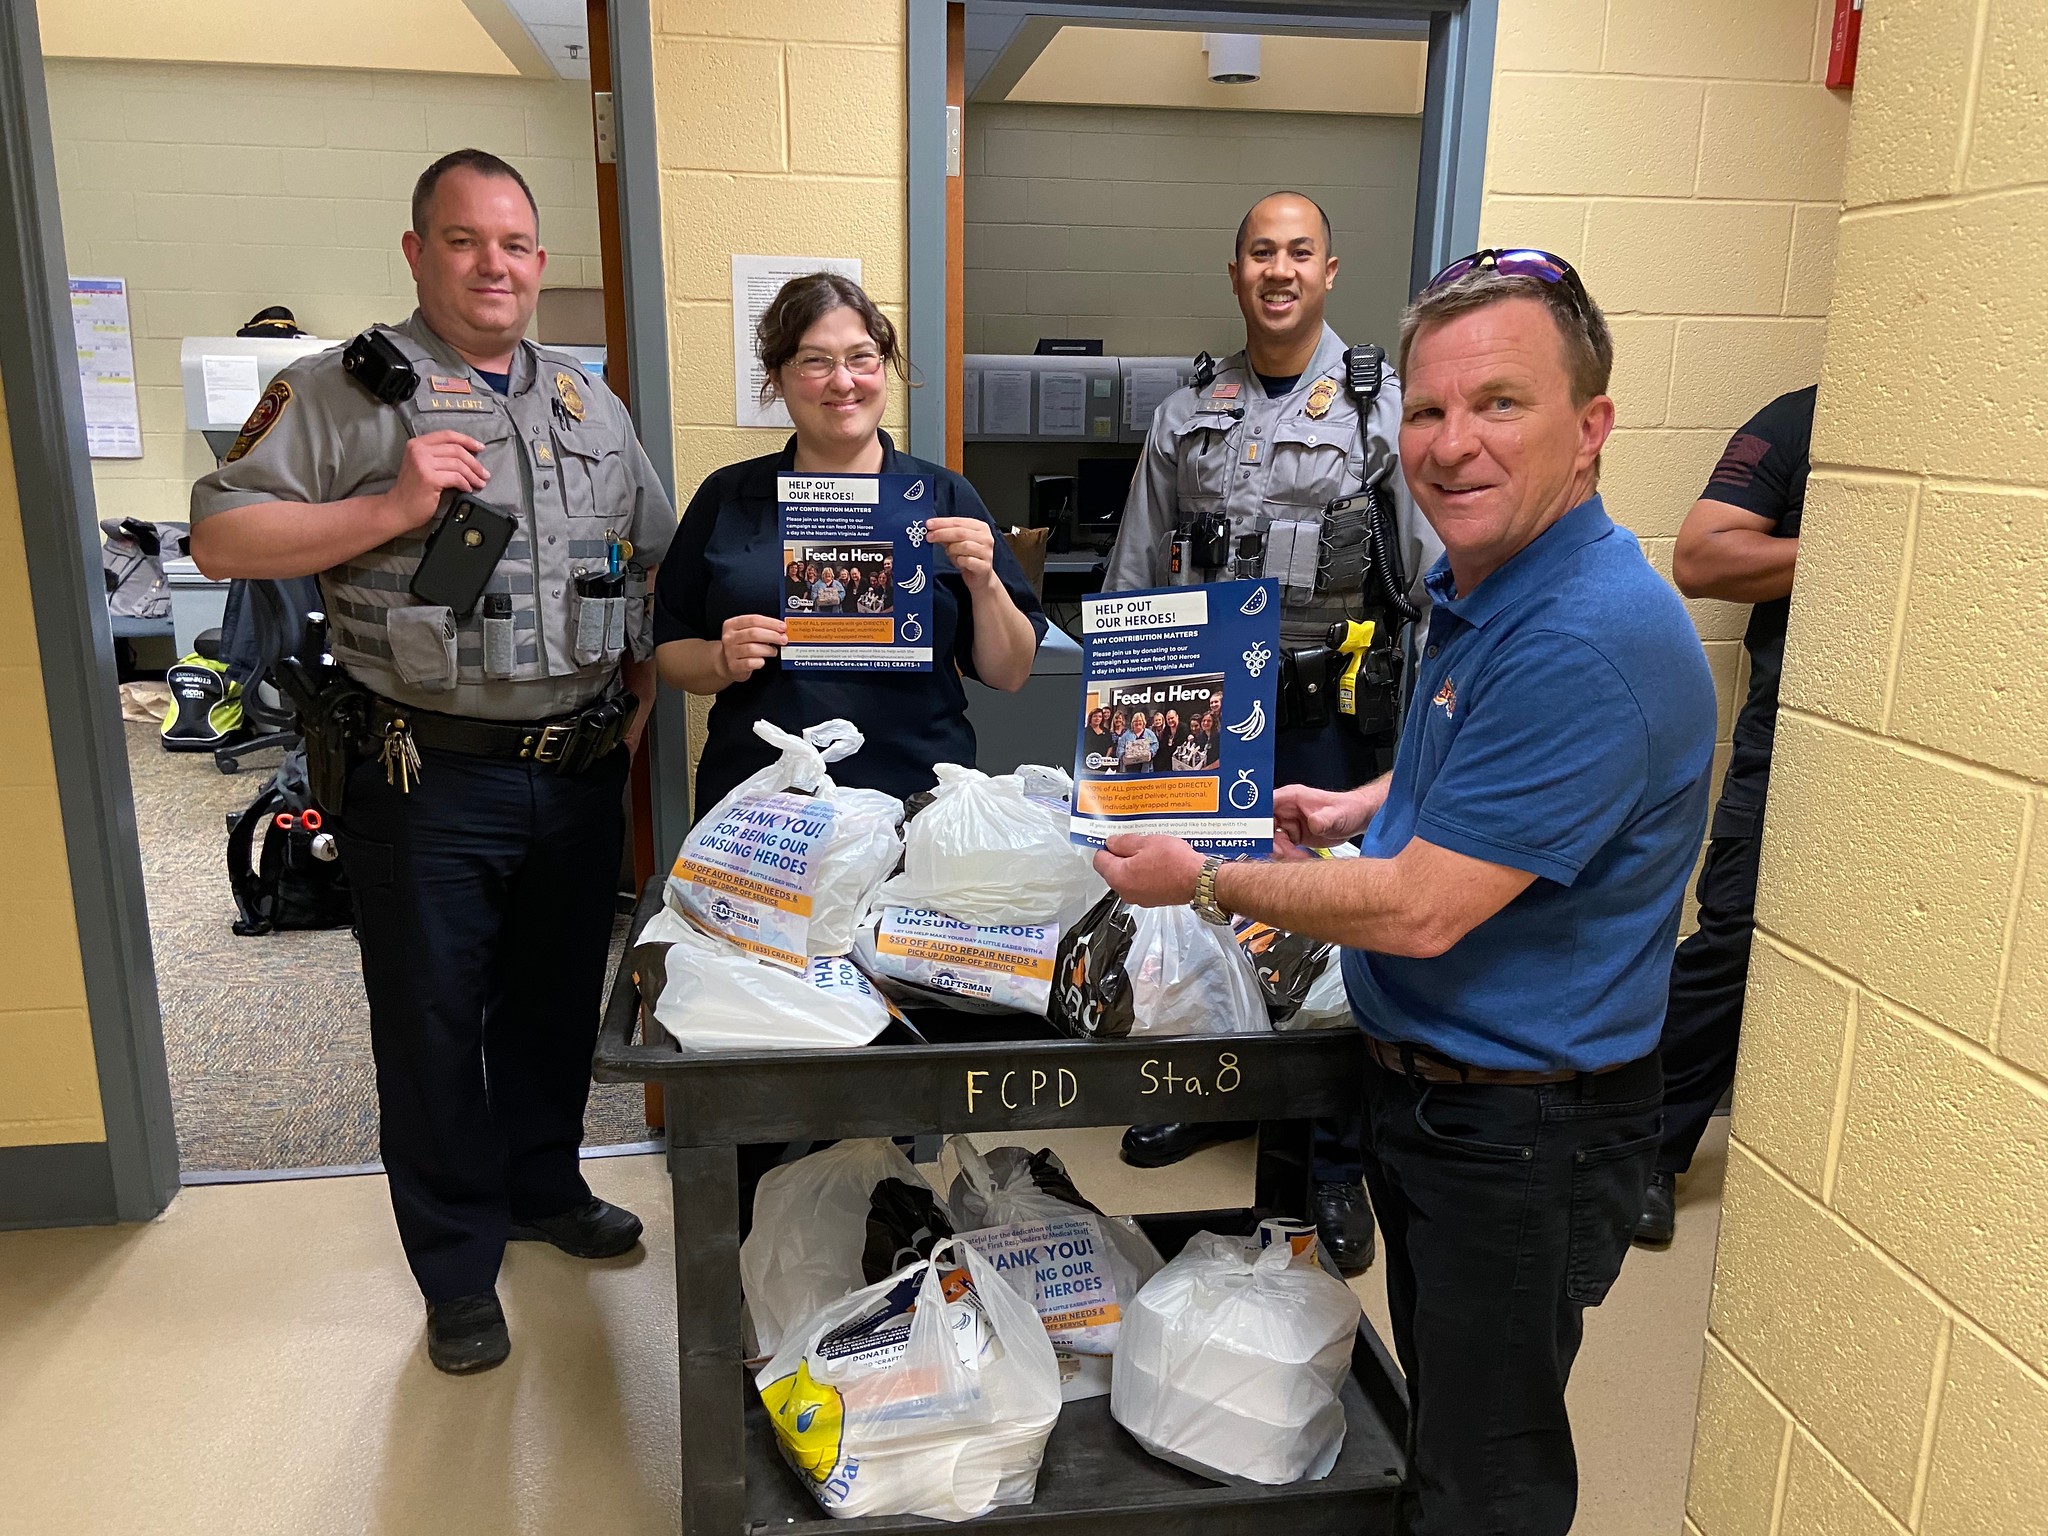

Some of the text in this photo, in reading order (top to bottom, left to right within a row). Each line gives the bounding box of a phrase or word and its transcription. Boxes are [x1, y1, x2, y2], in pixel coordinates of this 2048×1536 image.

[788, 481, 835, 490] HELP OUT
[789, 491, 854, 501] OUR HEROES!
[805, 548, 884, 562] Feed a Hero
[1095, 601, 1152, 615] HELP OUT
[1096, 612, 1176, 628] OUR HEROES!
[1109, 633, 1162, 643] CONTRIBUTION
[1163, 631, 1199, 639] MATTERS
[1133, 648, 1140, 656] by
[1141, 647, 1168, 655] donating
[1092, 658, 1121, 667] campaign
[1127, 665, 1154, 673] Northern
[1154, 663, 1178, 671] Virginia
[1112, 685, 1211, 706] Feed a Hero
[1125, 784, 1155, 792] proceeds
[1177, 781, 1213, 789] DIRECTLY
[1102, 803, 1140, 811] individually
[1140, 801, 1169, 810] wrapped
[724, 808, 826, 839] THANK YOU!
[713, 823, 809, 856] FOR BEING OUR
[1190, 840, 1213, 848] (833)
[699, 835, 808, 876] UNSUNG HEROES
[682, 860, 798, 903] $50 OFF AUTO REPAIR NEEDS &
[752, 891, 779, 906] SERVICE
[711, 904, 760, 925] CRAFTSMAN
[905, 909, 939, 917] FOR
[896, 917, 1045, 940] UNSUNG HEROES
[752, 944, 804, 965] (833) CRAFTS-1
[889, 935, 907, 944] $50
[909, 939, 929, 947] OFF
[930, 942, 957, 952] AUTO
[960, 947, 995, 959] REPAIR
[997, 953, 1029, 966] NEEDS
[907, 948, 1015, 972] PICK-UP SERVICE
[840, 963, 854, 986] FOR
[930, 977, 992, 993] CRAFTSMAN
[999, 1231, 1010, 1239] the
[1011, 1226, 1044, 1236] dedication
[1045, 1224, 1052, 1232] of
[1064, 1220, 1092, 1228] Doctors,
[987, 1227, 1089, 1250] First Responders Medical Staff
[1043, 1238, 1094, 1261] YOU!
[1062, 1261, 1094, 1277] OUR
[1044, 1276, 1103, 1299] HEROES
[1041, 1309, 1097, 1324] EPAIR NEEDS
[1059, 1319, 1088, 1329] SERVICE
[852, 1347, 890, 1362] DONATE
